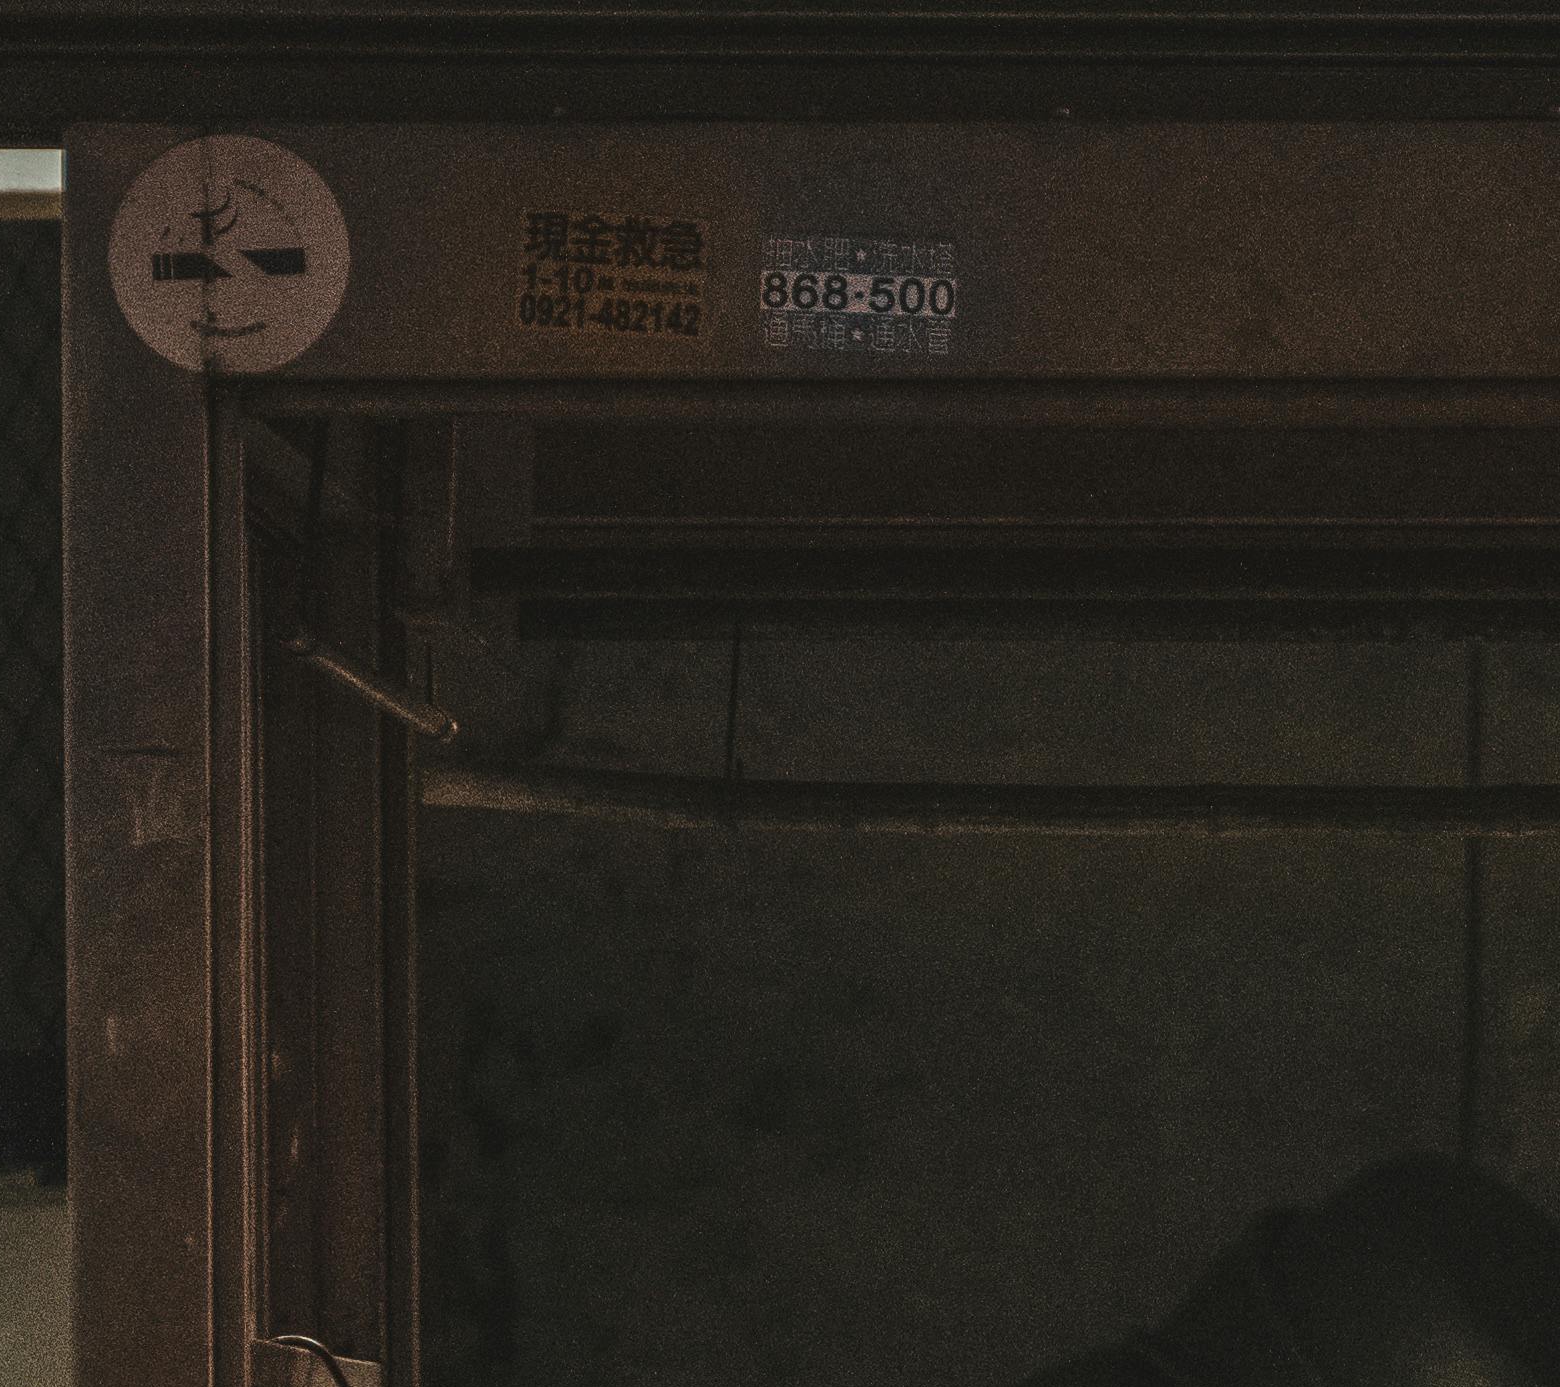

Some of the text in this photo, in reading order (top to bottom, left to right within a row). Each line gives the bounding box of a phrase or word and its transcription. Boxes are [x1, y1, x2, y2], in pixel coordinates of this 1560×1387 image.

[524, 211, 703, 270] 現金救急
[518, 292, 701, 337] 0921-482142
